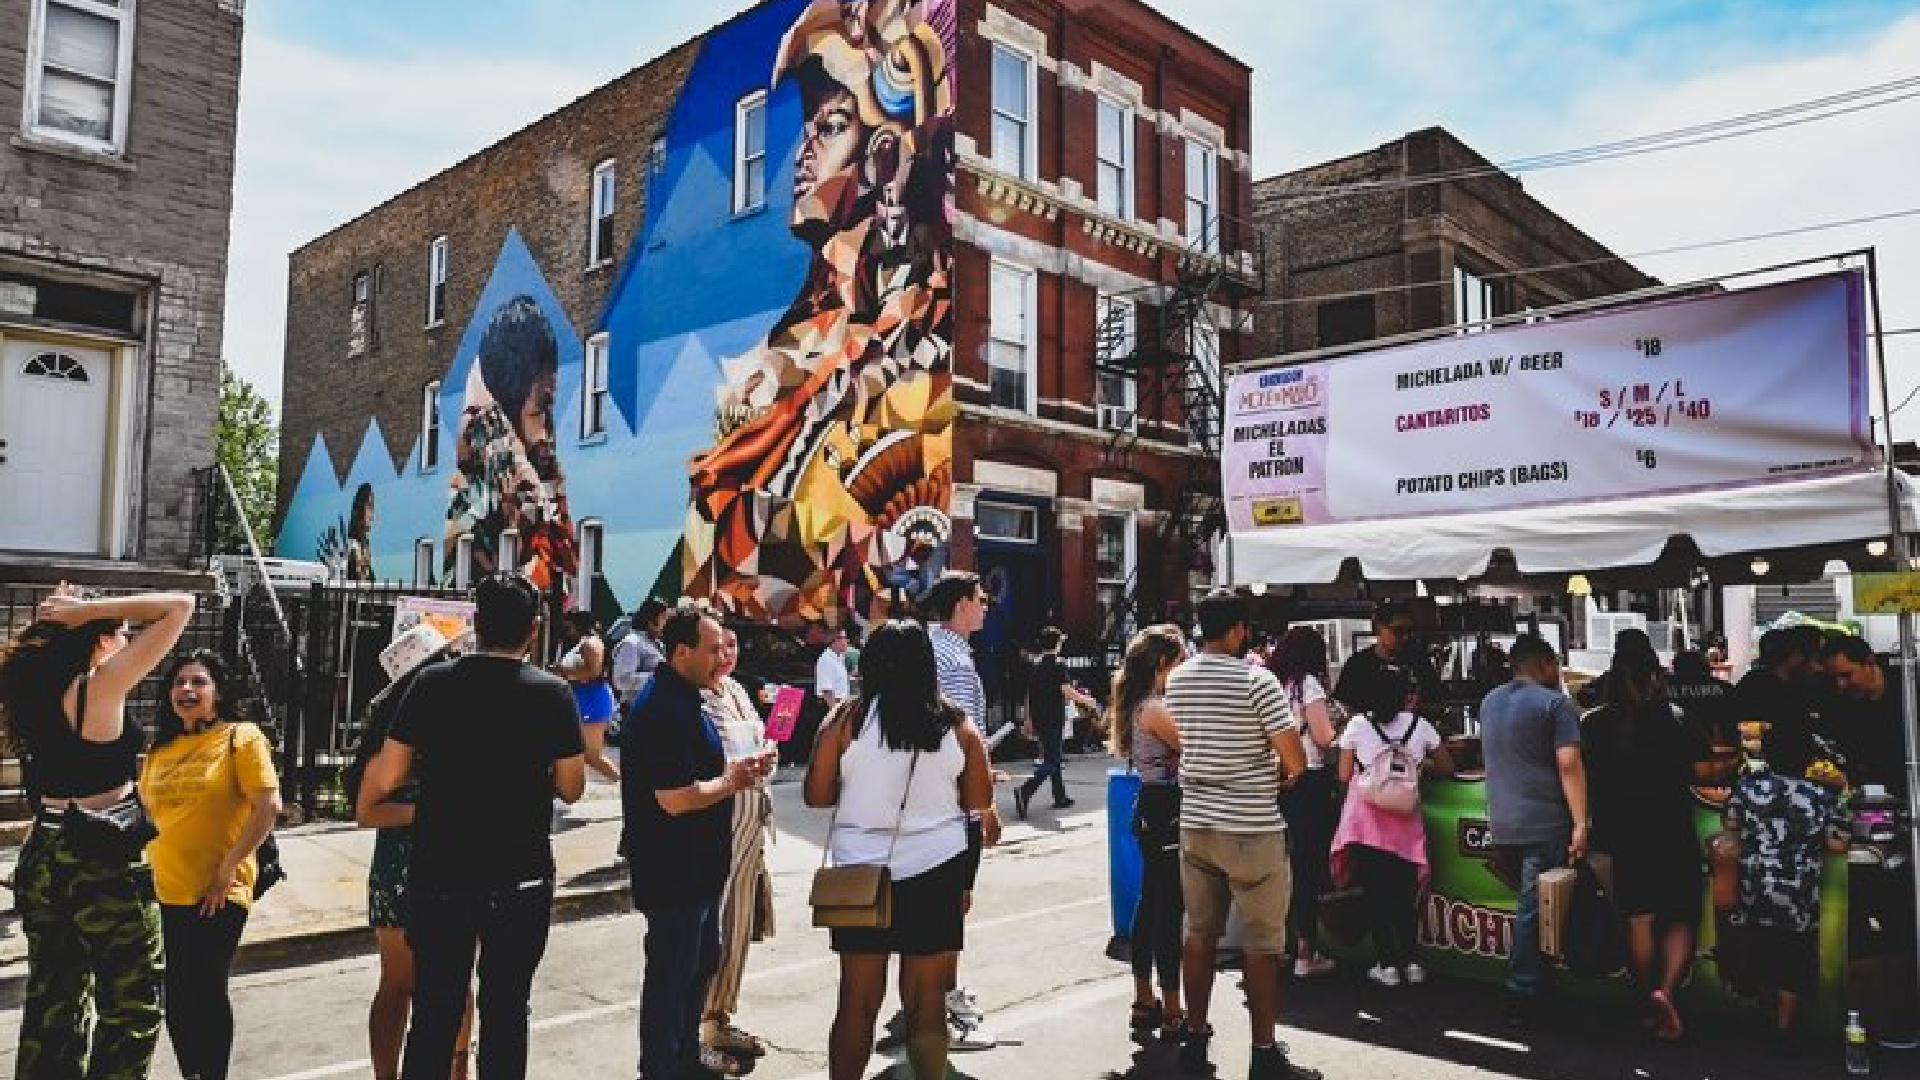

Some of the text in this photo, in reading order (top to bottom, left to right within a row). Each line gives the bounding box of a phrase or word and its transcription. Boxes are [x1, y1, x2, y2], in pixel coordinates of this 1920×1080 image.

[1635, 337, 1661, 357] $18
[1395, 351, 1563, 391] MICHELADA W/ BEER
[1599, 388, 1612, 409] S
[1632, 382, 1650, 404] M
[1674, 378, 1685, 397] L
[1395, 403, 1491, 433] CANTARITOS
[1573, 409, 1601, 429] $18
[1626, 405, 1657, 428] $25
[1678, 398, 1710, 420] $40
[1233, 416, 1327, 443] MICHELADAS
[1268, 440, 1285, 457] EL
[1635, 449, 1657, 469] $6
[1248, 456, 1304, 480] PATRON
[1395, 461, 1568, 494] POTATO CHIPS (BAGS)
[1417, 894, 1517, 960] ICH
